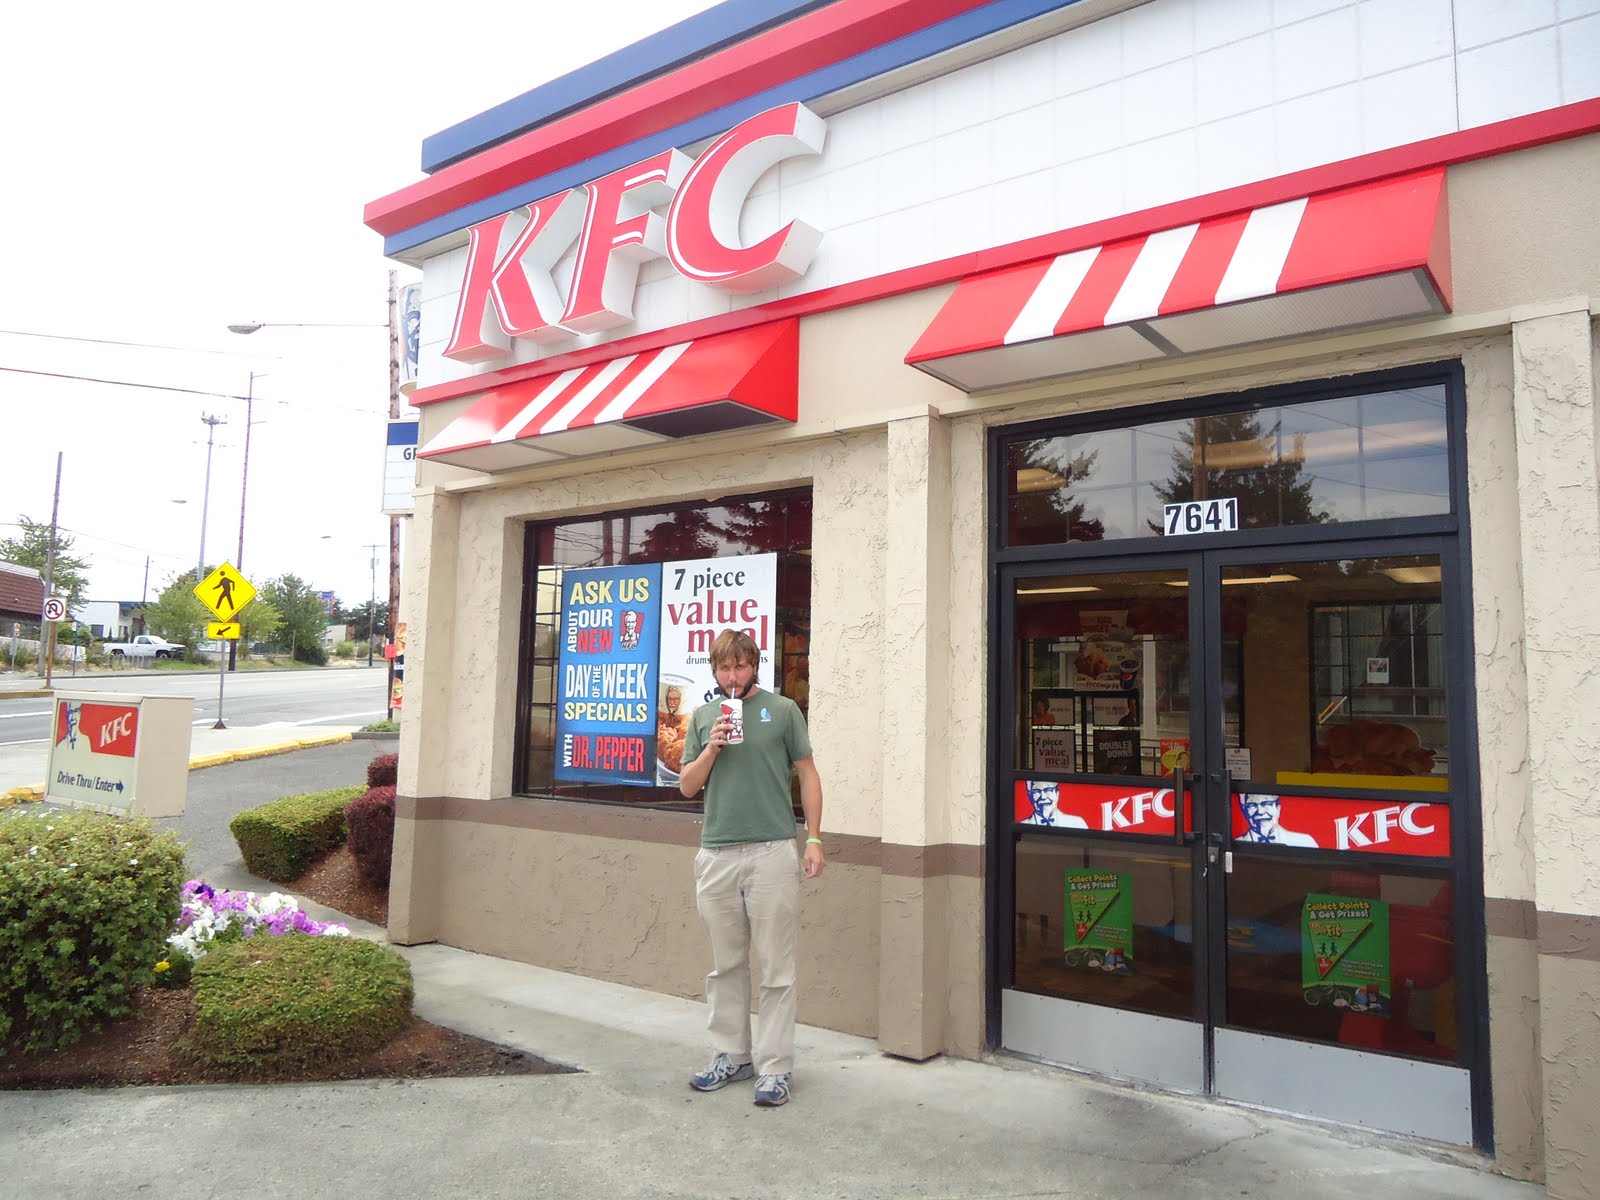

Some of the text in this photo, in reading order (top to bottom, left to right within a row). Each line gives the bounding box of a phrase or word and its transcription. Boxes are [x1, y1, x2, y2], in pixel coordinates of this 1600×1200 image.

[442, 102, 820, 360] KFC
[1165, 499, 1236, 535] 7641
[569, 577, 650, 606] ASK US
[674, 567, 746, 597] 7 piece
[578, 608, 613, 628] OUR
[667, 589, 759, 626] value
[567, 610, 579, 653] ABOUT
[577, 628, 614, 654] NEW
[687, 614, 769, 653] ml
[565, 664, 592, 698] DAY
[592, 665, 602, 698] OF THE
[602, 663, 649, 700] WEEK
[564, 701, 648, 723] SPECIALS
[99, 712, 132, 748] KFC
[1042, 737, 1064, 748] piece
[1099, 741, 1129, 751] DOUBLE
[563, 733, 573, 767] WITH
[572, 735, 645, 772] DR. PEPPER
[1040, 748, 1066, 757] value
[1045, 755, 1069, 766] meal
[57, 771, 75, 785] Drive
[95, 777, 116, 792] Enter
[1101, 788, 1175, 831] KFC
[1333, 802, 1436, 850] KFC
[1306, 901, 1370, 911] Collect Points
[1318, 911, 1336, 919] Get
[1337, 909, 1369, 918] Prizes!
